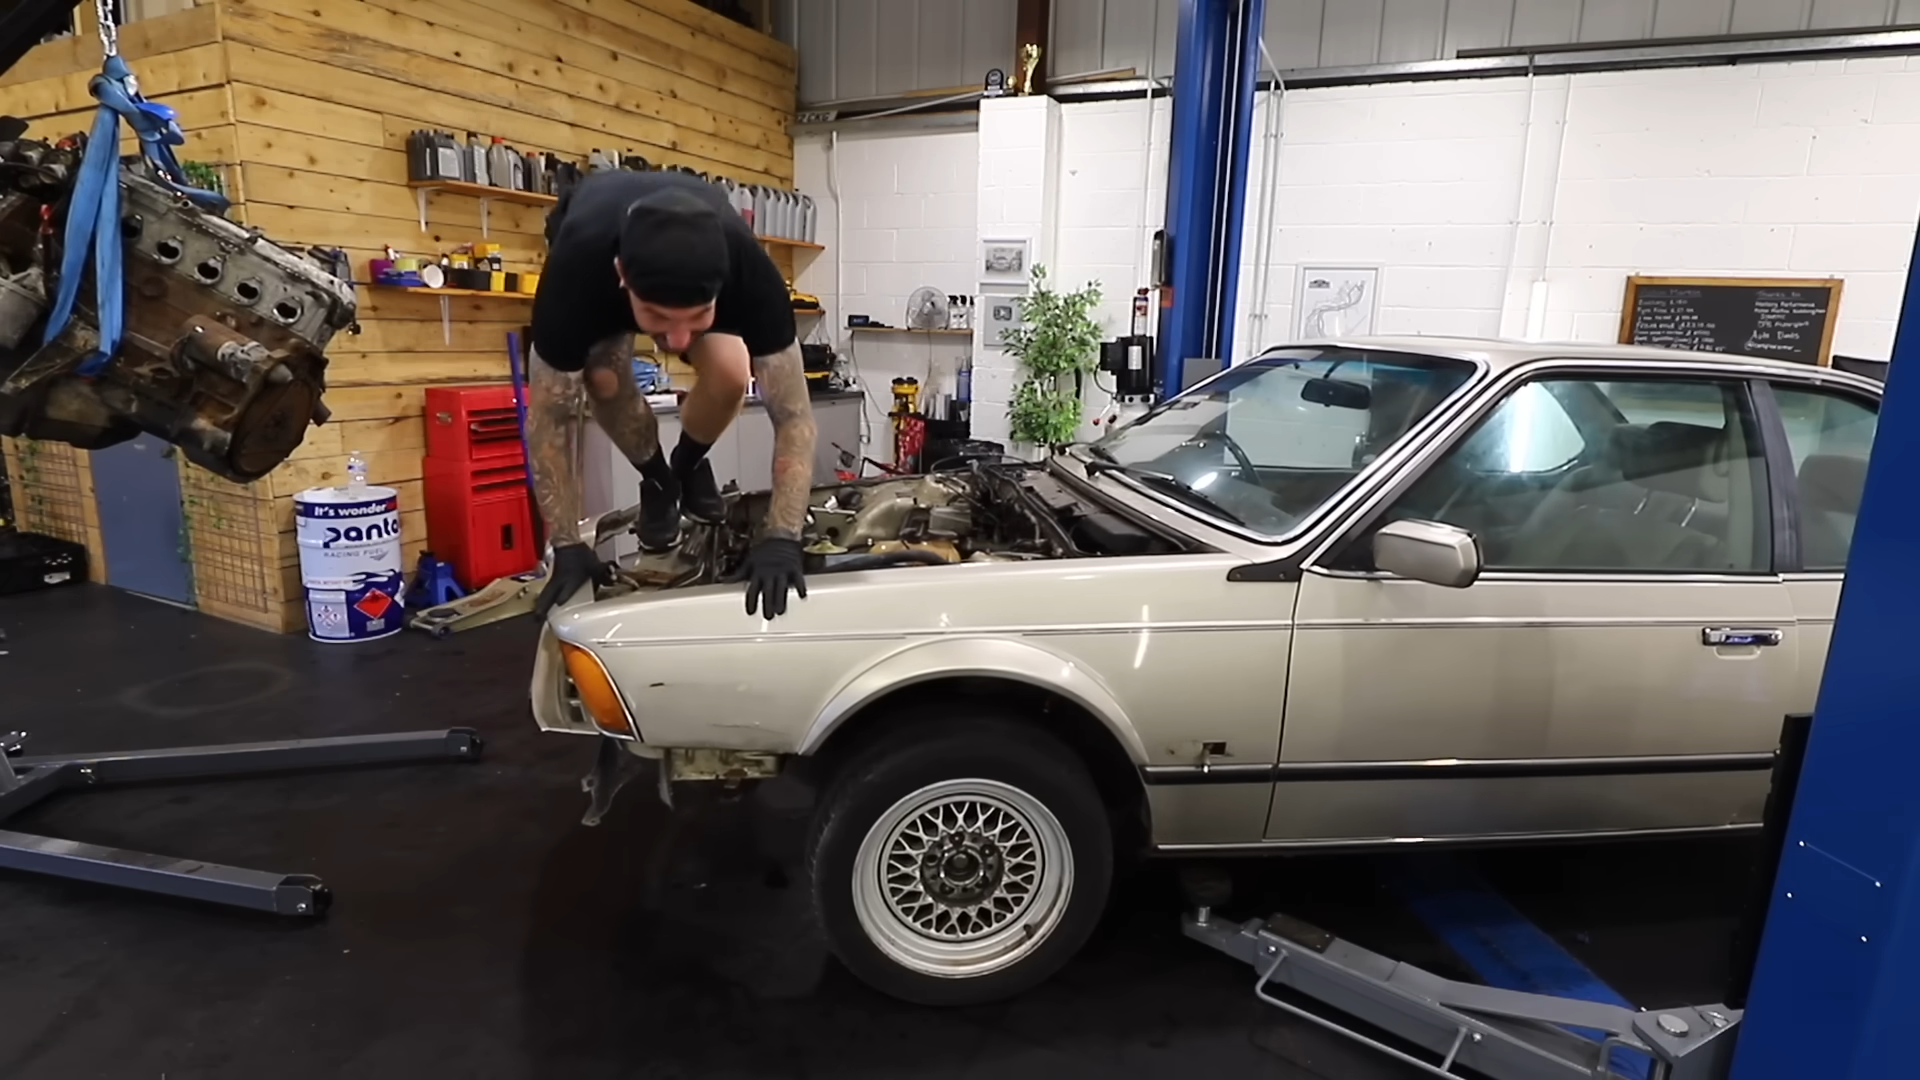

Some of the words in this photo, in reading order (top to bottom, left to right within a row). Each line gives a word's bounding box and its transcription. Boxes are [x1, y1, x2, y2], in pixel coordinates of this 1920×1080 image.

[314, 506, 335, 516] It's
[323, 550, 360, 558] RACING
[363, 548, 384, 556] FUEL
